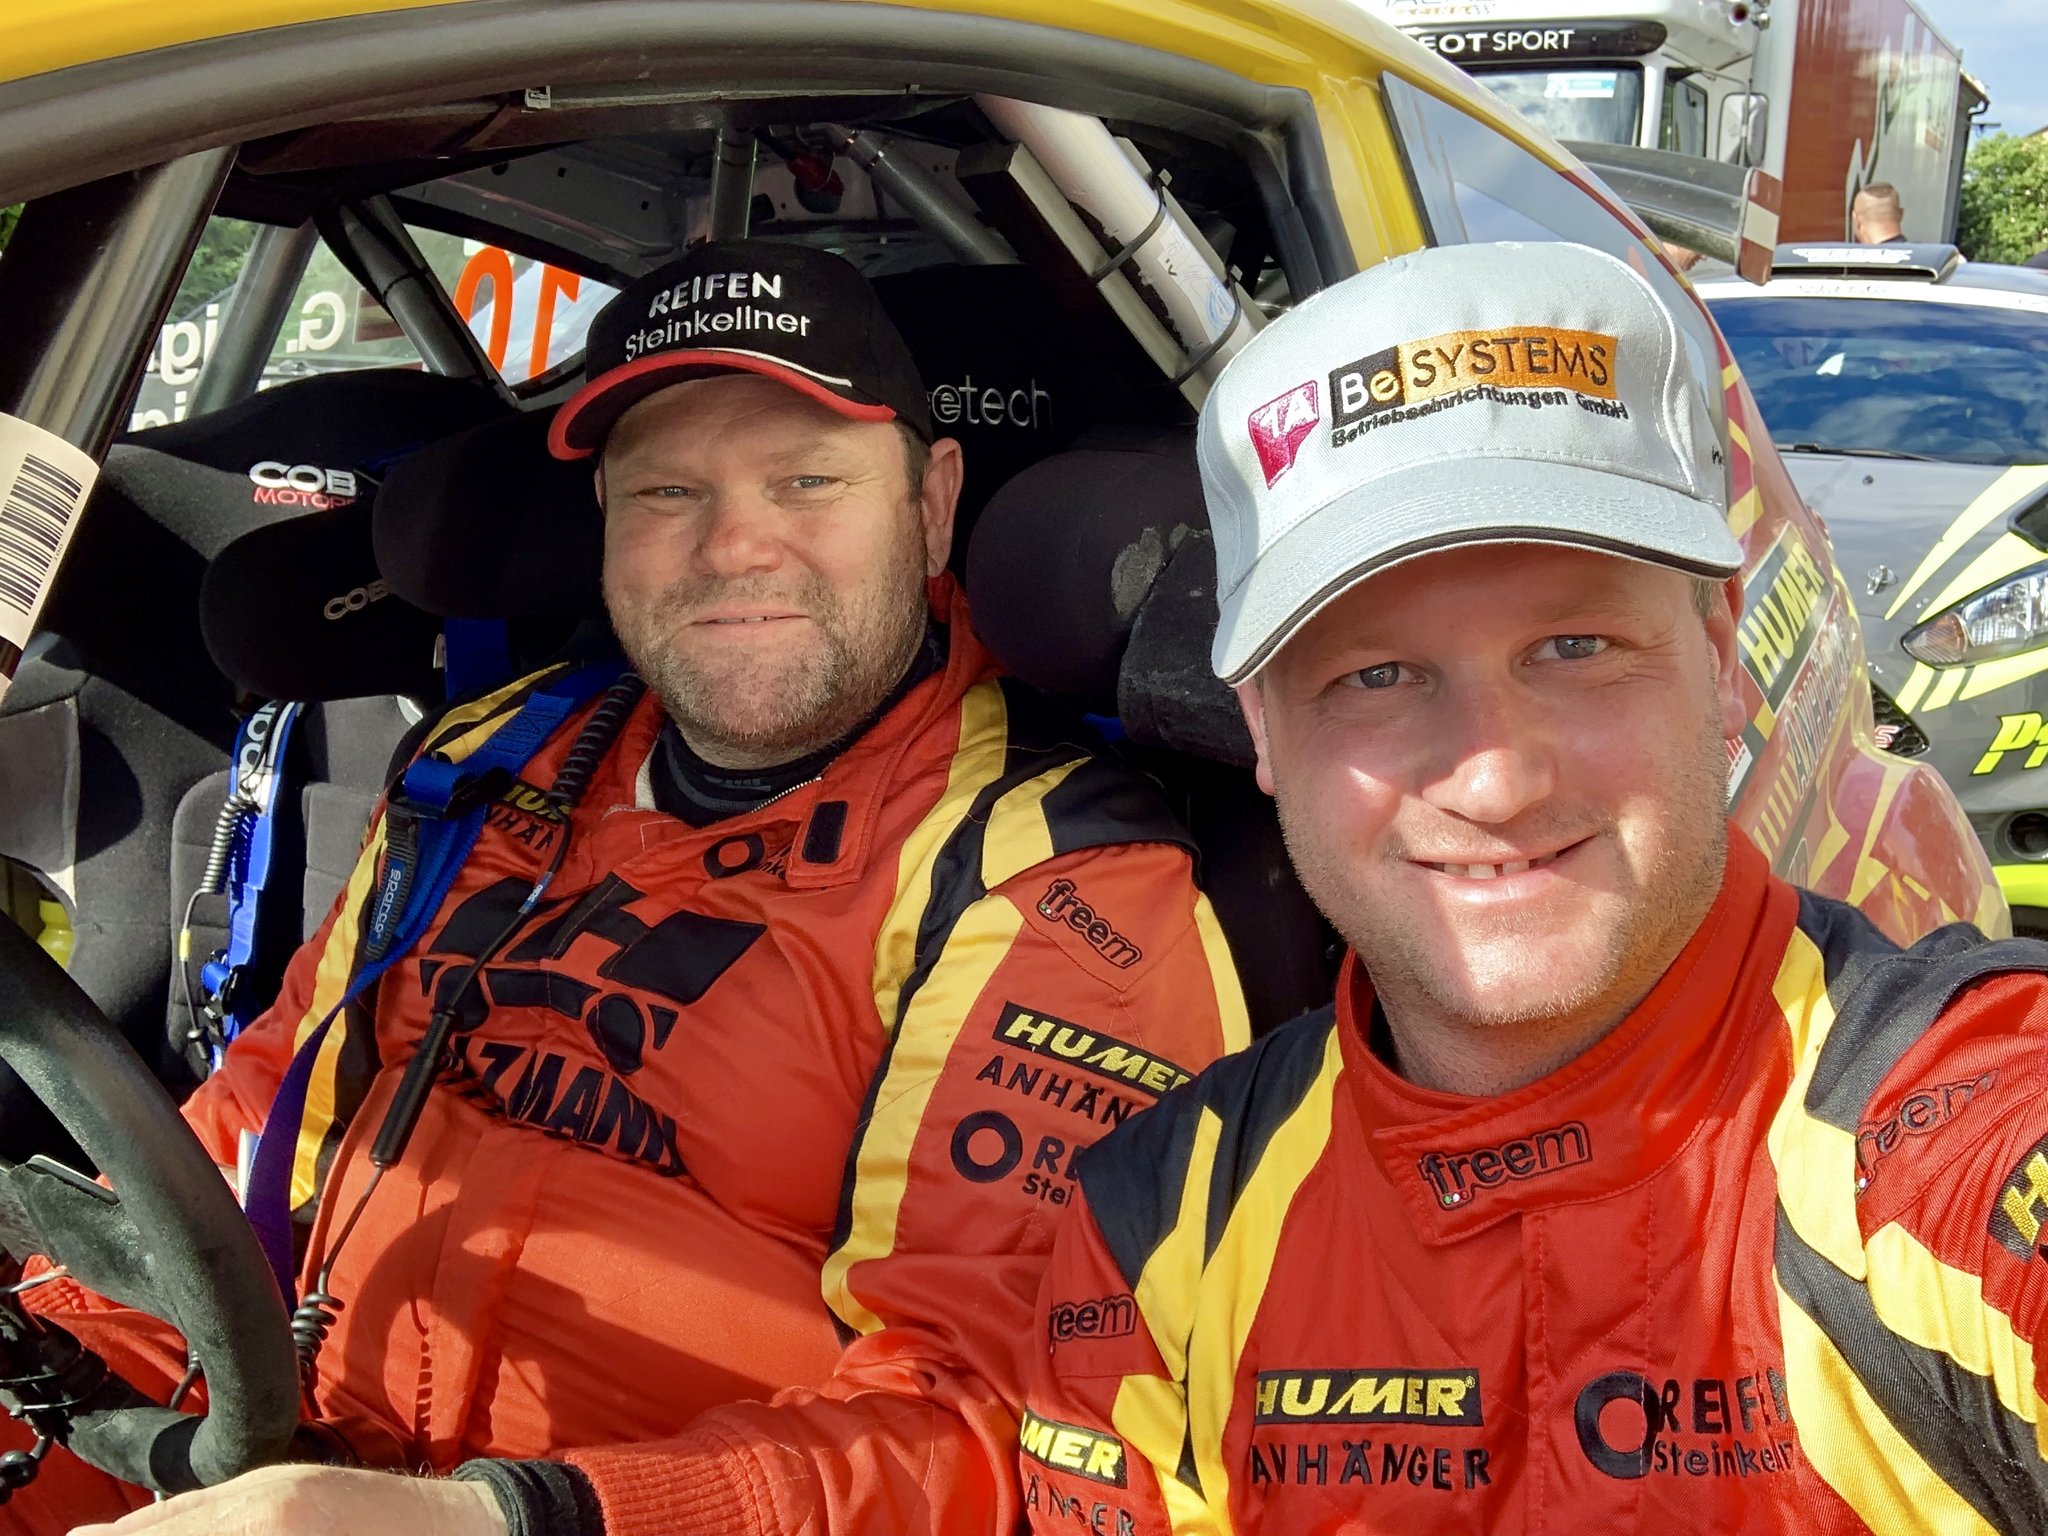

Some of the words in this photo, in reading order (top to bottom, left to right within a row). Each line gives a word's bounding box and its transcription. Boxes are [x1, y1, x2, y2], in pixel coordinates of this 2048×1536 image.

[1418, 34, 1489, 53] EOT
[1492, 28, 1576, 51] SPORT
[649, 271, 782, 318] REIFEN
[625, 305, 811, 362] Steinkellner
[1411, 336, 1608, 388] SYSTEMS
[928, 375, 1054, 430] etech
[1332, 383, 1569, 448] Betriebseinrichtungen
[1575, 389, 1630, 420] GmbH
[249, 461, 357, 497] COB
[324, 578, 390, 620] COB
[1737, 541, 1826, 689] HUMER
[375, 868, 401, 934] sparco
[1042, 880, 1140, 967] freem
[976, 1055, 1133, 1126] ANHÄN
[1426, 1126, 1586, 1195] freem
[1022, 1173, 1076, 1209] Stei
[2002, 1151, 2048, 1246] H
[1020, 1412, 1122, 1480] MER
[1251, 1440, 1492, 1490] ANHÄNGER
